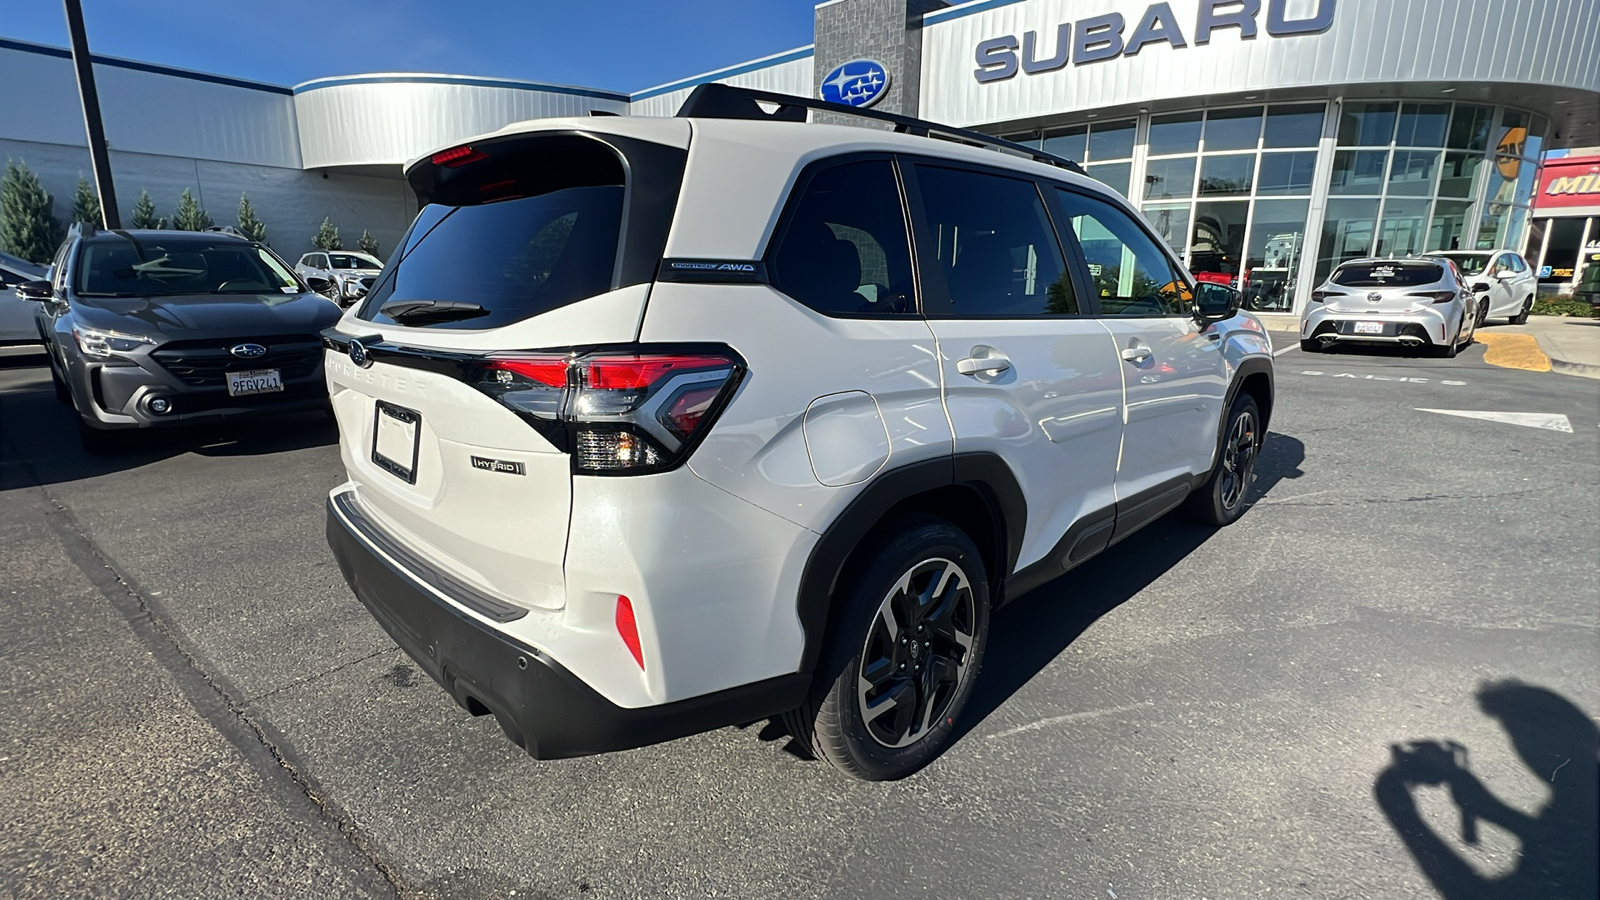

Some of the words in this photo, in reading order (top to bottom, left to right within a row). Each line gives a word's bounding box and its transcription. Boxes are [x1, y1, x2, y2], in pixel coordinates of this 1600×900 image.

[974, 0, 1336, 84] SUBARU
[718, 263, 755, 271] AWD
[233, 377, 279, 393] 9FGV241
[328, 358, 428, 398] FORESTER
[477, 460, 515, 471] HYBRID
